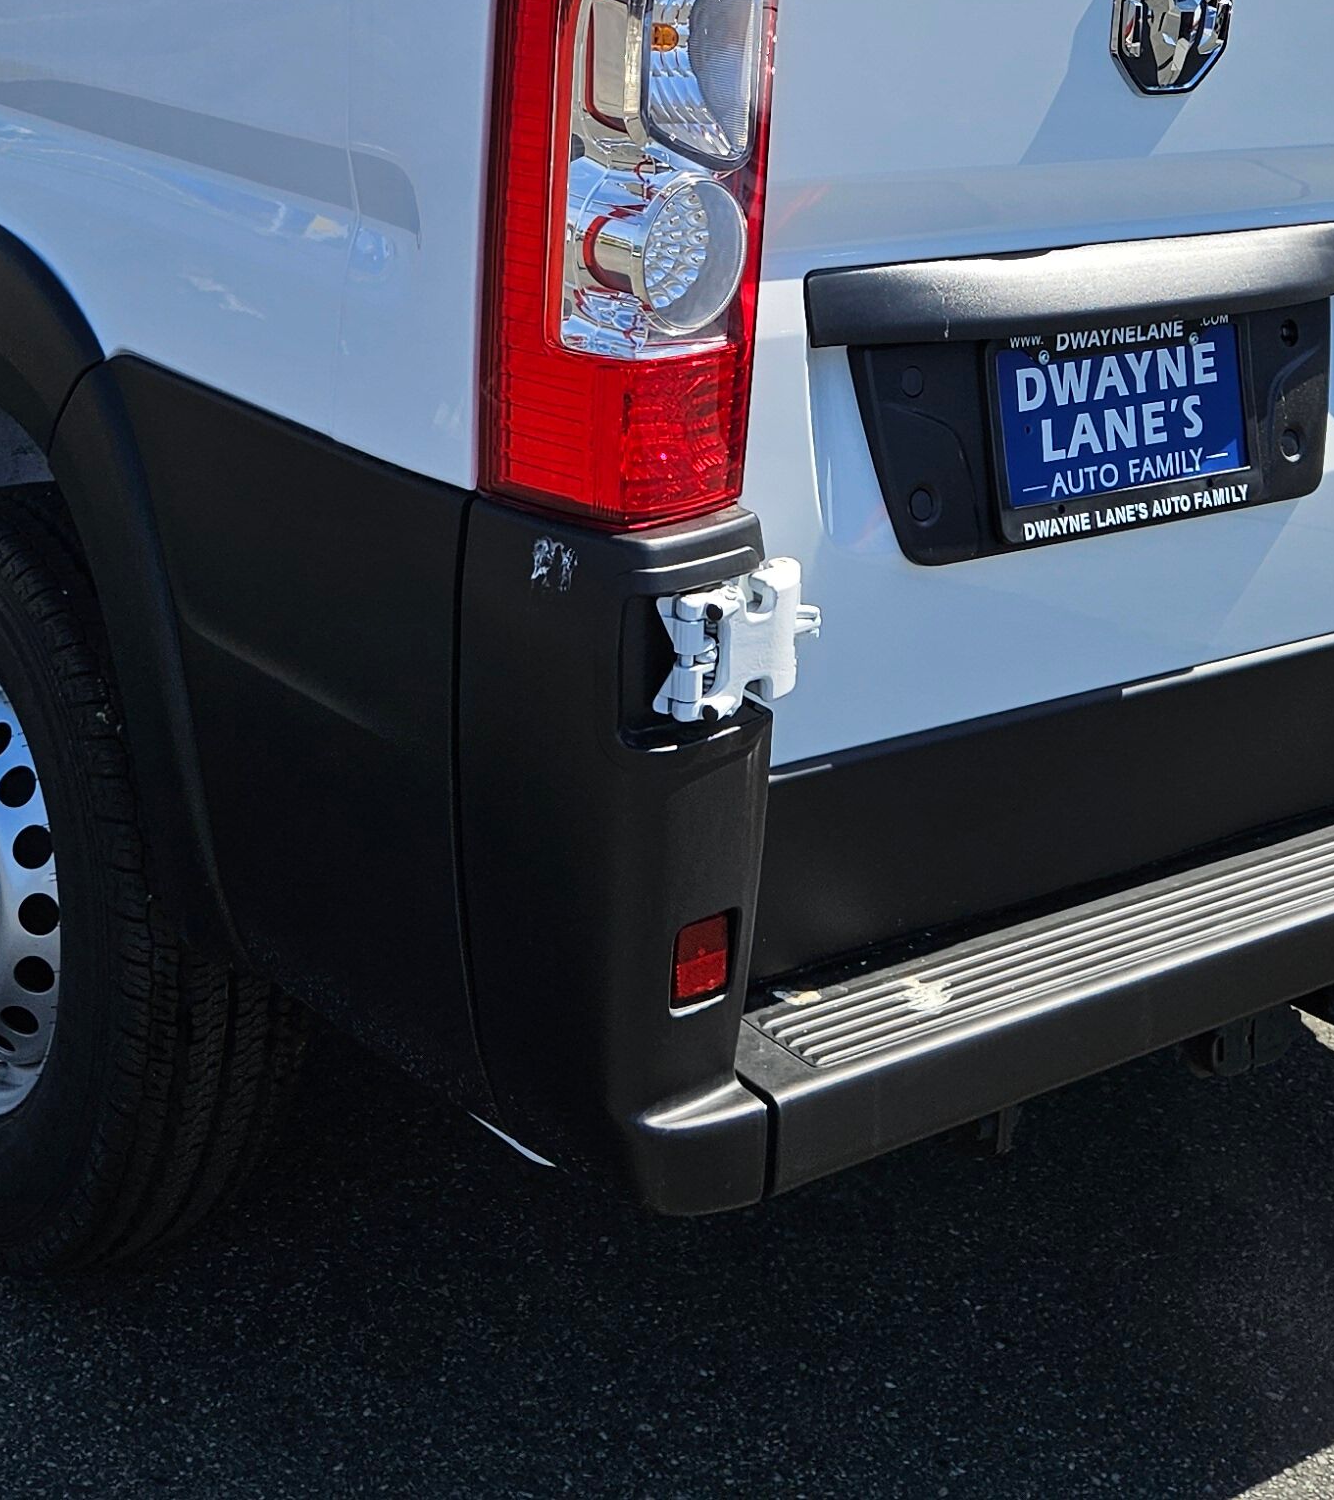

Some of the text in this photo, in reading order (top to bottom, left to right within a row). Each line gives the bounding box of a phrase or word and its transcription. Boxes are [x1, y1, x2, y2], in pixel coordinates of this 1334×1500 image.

[1056, 320, 1184, 351] DWAYNELANE
[1016, 341, 1217, 413] DWAYNE
[1041, 394, 1204, 463] LANE'S
[1051, 447, 1204, 498] AUTO FAMILY
[1023, 483, 1249, 542] DWAYNE LANE'S AUTO FAMILY
